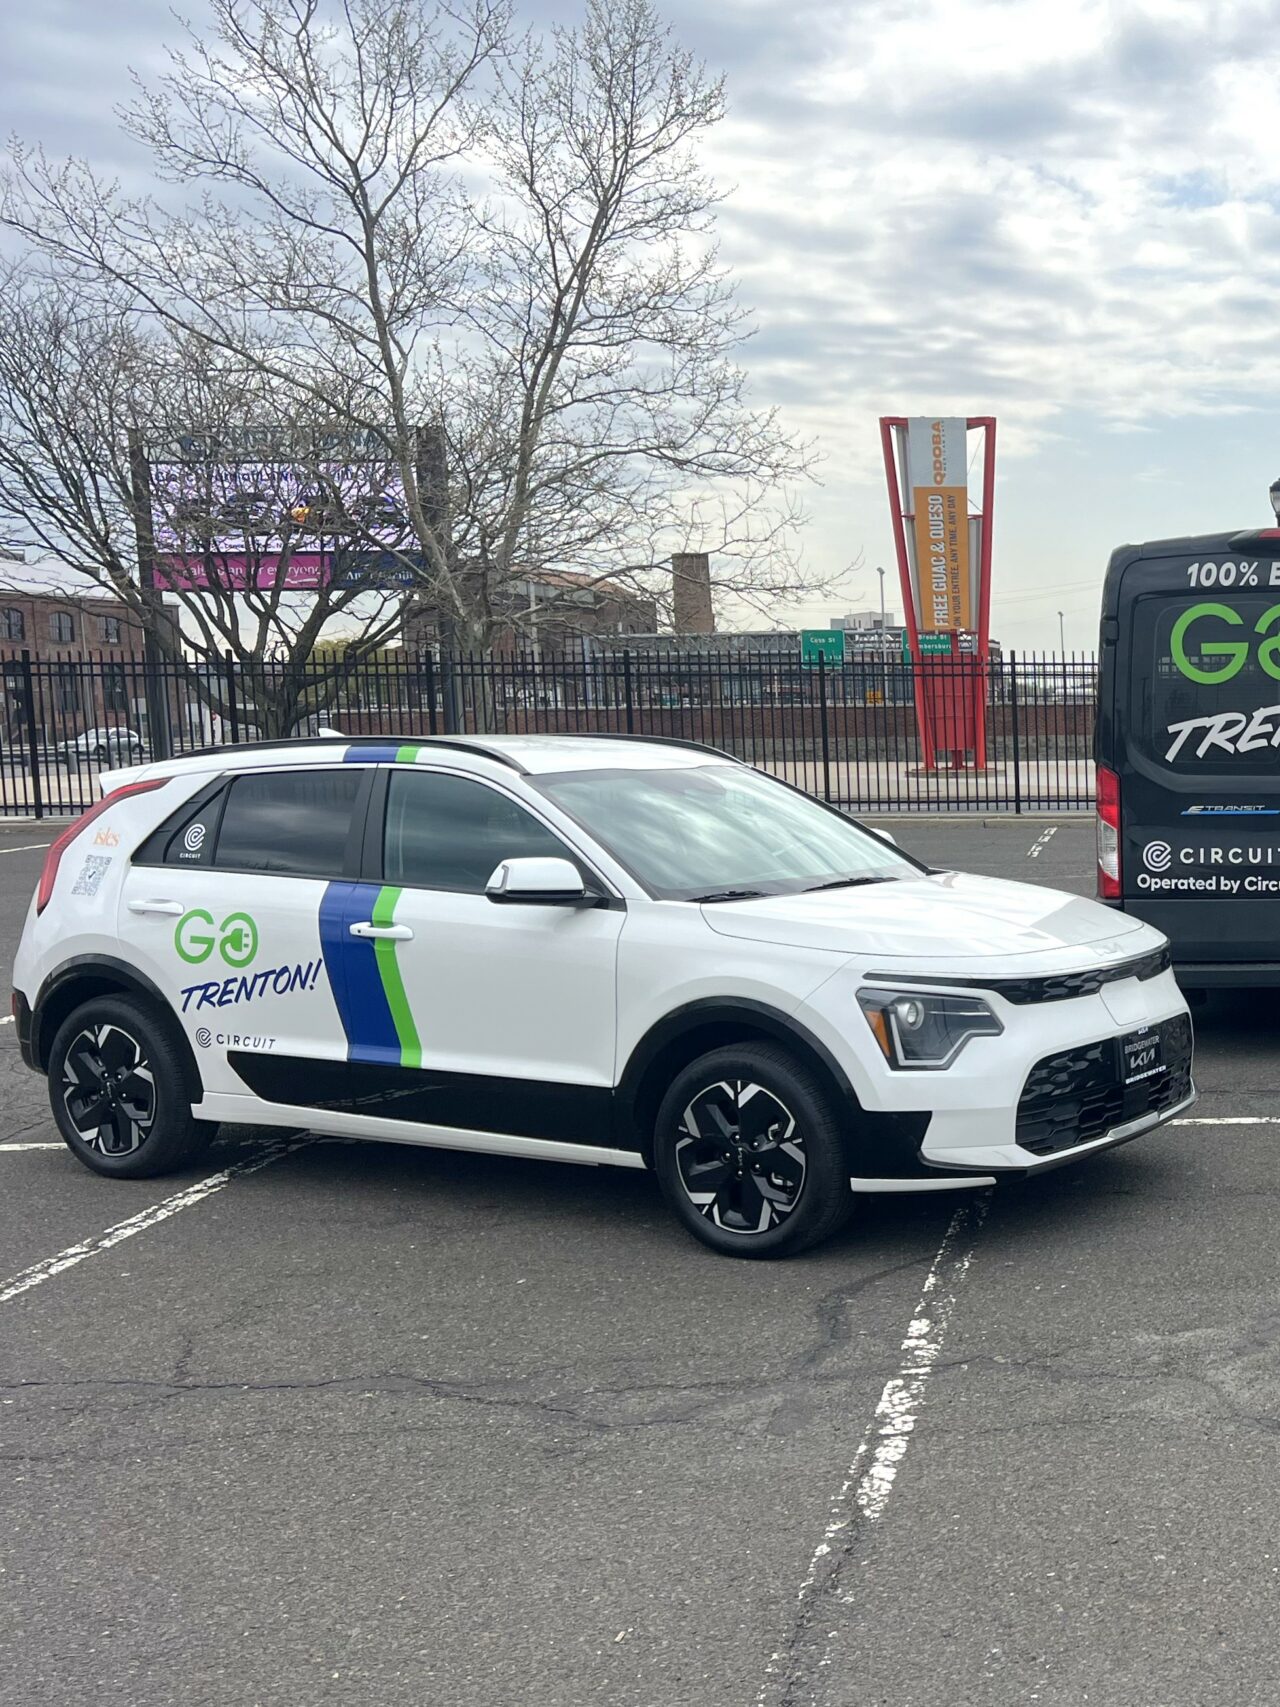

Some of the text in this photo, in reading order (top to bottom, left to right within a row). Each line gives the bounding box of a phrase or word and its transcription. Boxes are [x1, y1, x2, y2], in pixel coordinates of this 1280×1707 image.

[931, 421, 945, 486] QDOBA
[947, 494, 956, 508] DAY
[948, 510, 956, 525] ANY
[928, 494, 949, 626] FREE GUAC & QUESO
[950, 548, 958, 563] ANY
[1186, 561, 1259, 587] 100%
[952, 594, 961, 615] YOUR
[953, 615, 961, 627] ON
[93, 827, 120, 847] isles
[1137, 874, 1217, 891] Operated
[1220, 876, 1240, 894] by
[174, 908, 258, 968] GO
[181, 958, 322, 1013] TRENTON!
[217, 1034, 276, 1049] CIRCUIT
[1124, 1035, 1160, 1054] BRIDGEWATER
[1130, 1048, 1155, 1069] KIA
[1125, 1065, 1167, 1085] BRIDGEWATER
